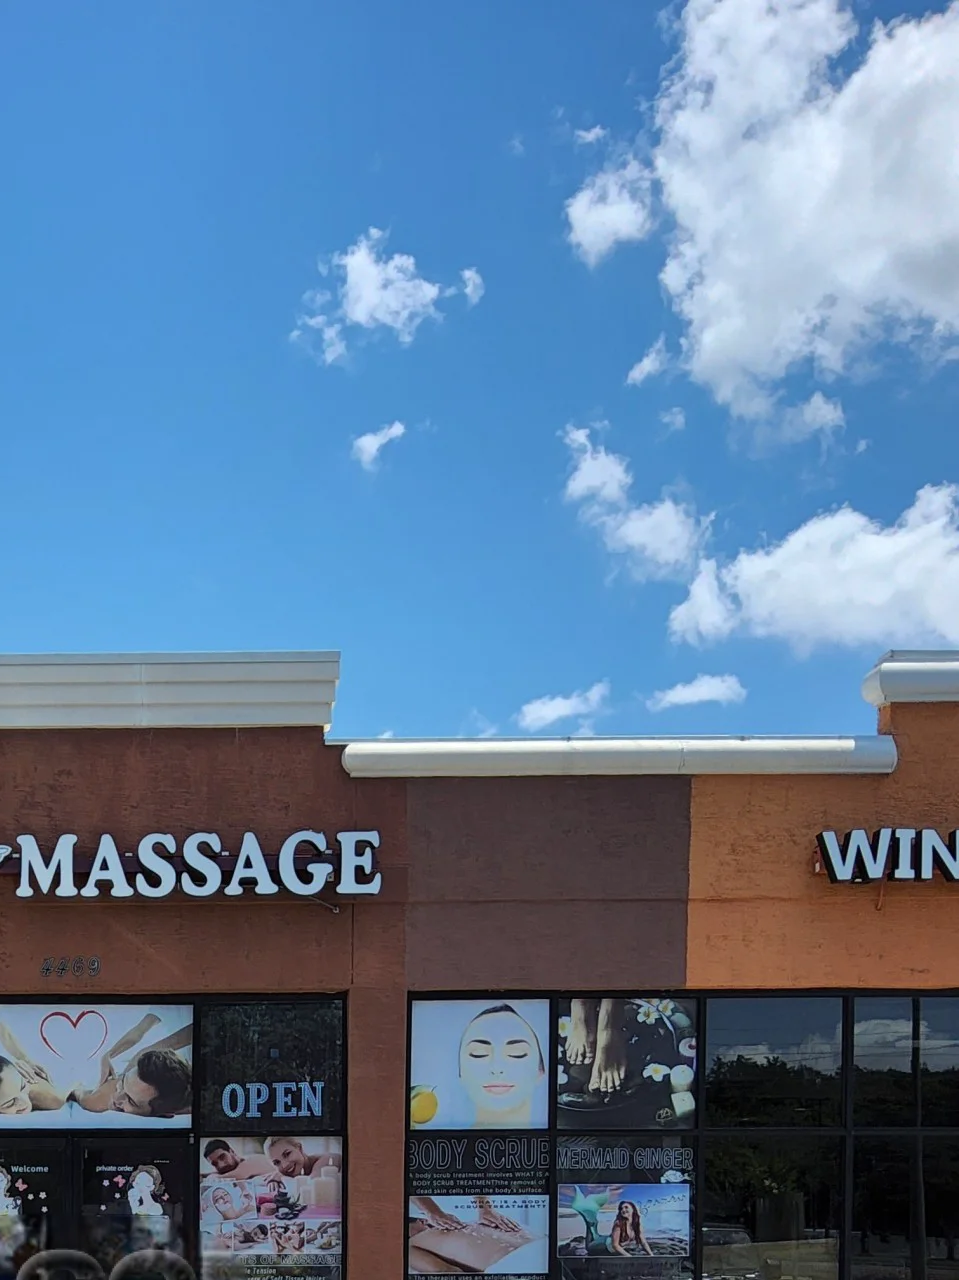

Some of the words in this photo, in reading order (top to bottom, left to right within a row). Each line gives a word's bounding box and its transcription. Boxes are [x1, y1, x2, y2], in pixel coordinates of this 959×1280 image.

[16, 830, 382, 898] MASSAGE
[819, 828, 959, 880] WIN
[41, 956, 102, 977] 4469
[221, 1081, 325, 1118] OPEN
[409, 1138, 468, 1170] BODY
[474, 1138, 550, 1170] SCRUB
[556, 1147, 630, 1170] MERMAID
[633, 1147, 694, 1170] GINGER
[10, 1165, 49, 1173] Welcome
[95, 1164, 117, 1173] private
[415, 1172, 431, 1180] body
